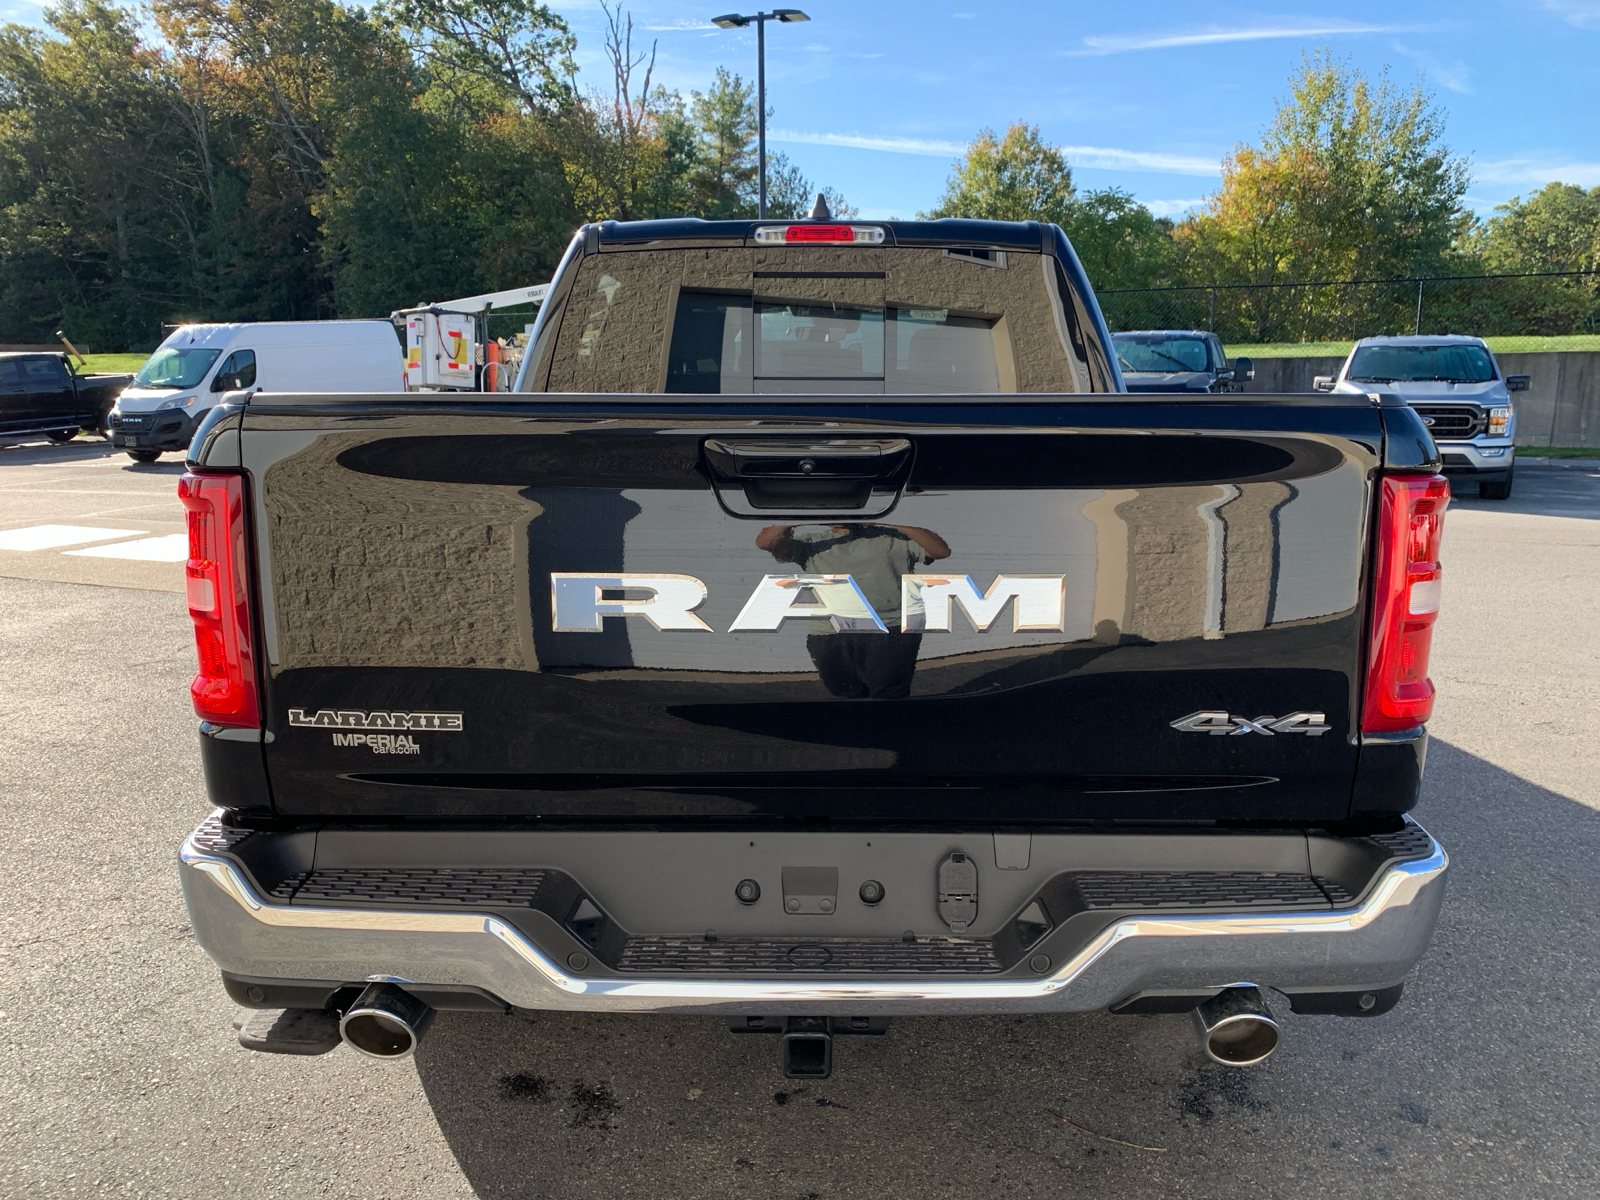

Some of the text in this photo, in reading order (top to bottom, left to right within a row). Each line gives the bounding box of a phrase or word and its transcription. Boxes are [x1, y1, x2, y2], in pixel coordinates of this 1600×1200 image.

[550, 572, 1066, 633] RAM
[288, 708, 462, 731] LARAMIE
[332, 733, 420, 748] IMPERIAL
[372, 744, 420, 755] cars.com
